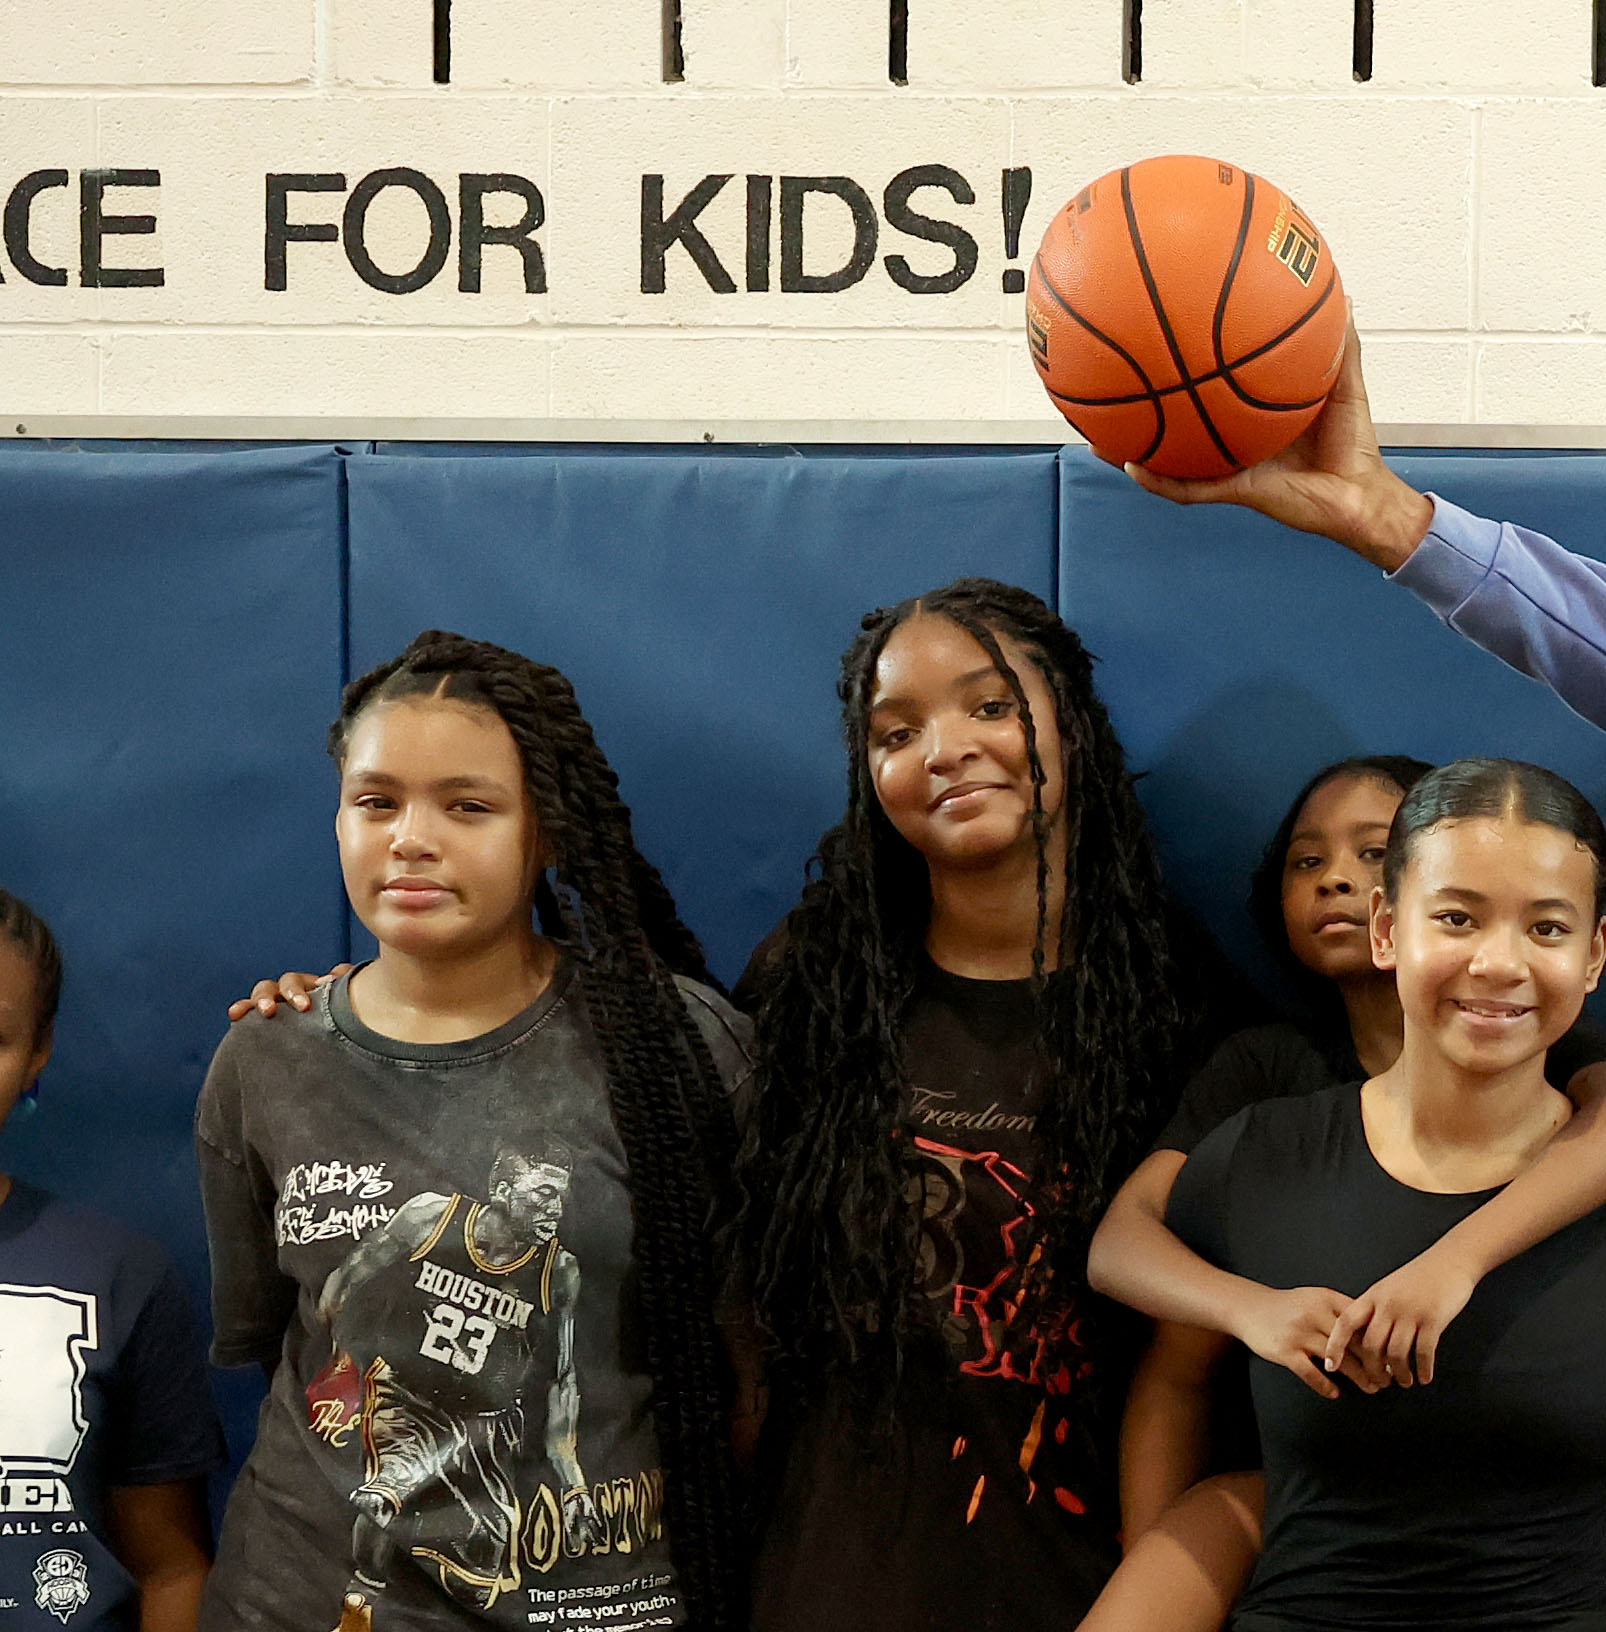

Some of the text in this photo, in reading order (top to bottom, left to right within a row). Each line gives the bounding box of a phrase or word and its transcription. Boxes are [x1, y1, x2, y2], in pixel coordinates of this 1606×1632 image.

[0, 163, 1033, 295] CE FOR KIDS!
[909, 1086, 1037, 1133] Freedom
[414, 1259, 535, 1330] HOUSTON
[419, 1303, 498, 1375] 23
[527, 1573, 672, 1604] The passage of time
[527, 1609, 556, 1624] may
[557, 1605, 593, 1620] fade
[592, 1602, 629, 1621] your
